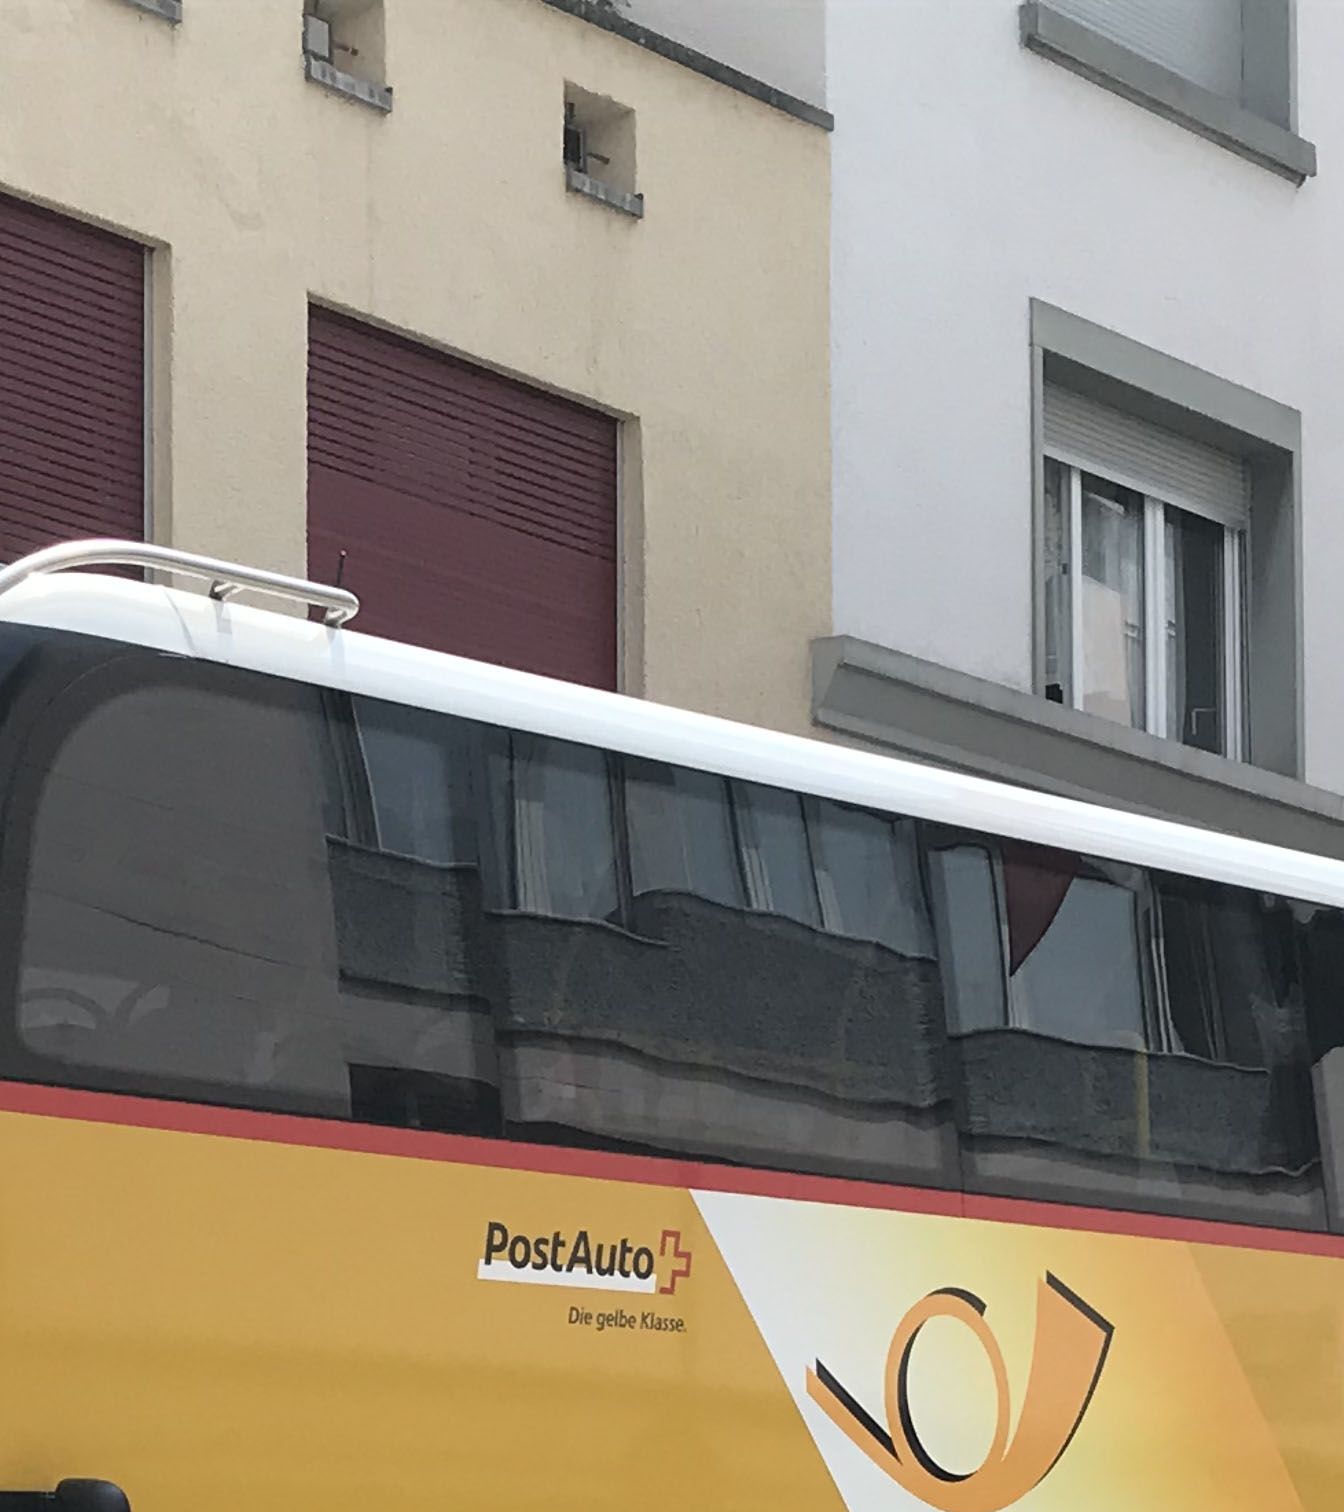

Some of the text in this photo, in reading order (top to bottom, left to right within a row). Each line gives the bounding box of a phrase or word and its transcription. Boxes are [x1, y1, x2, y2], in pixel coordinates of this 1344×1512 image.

[484, 1221, 655, 1280] PostAuto
[568, 1306, 687, 1333] Die gelbe Klasse.
